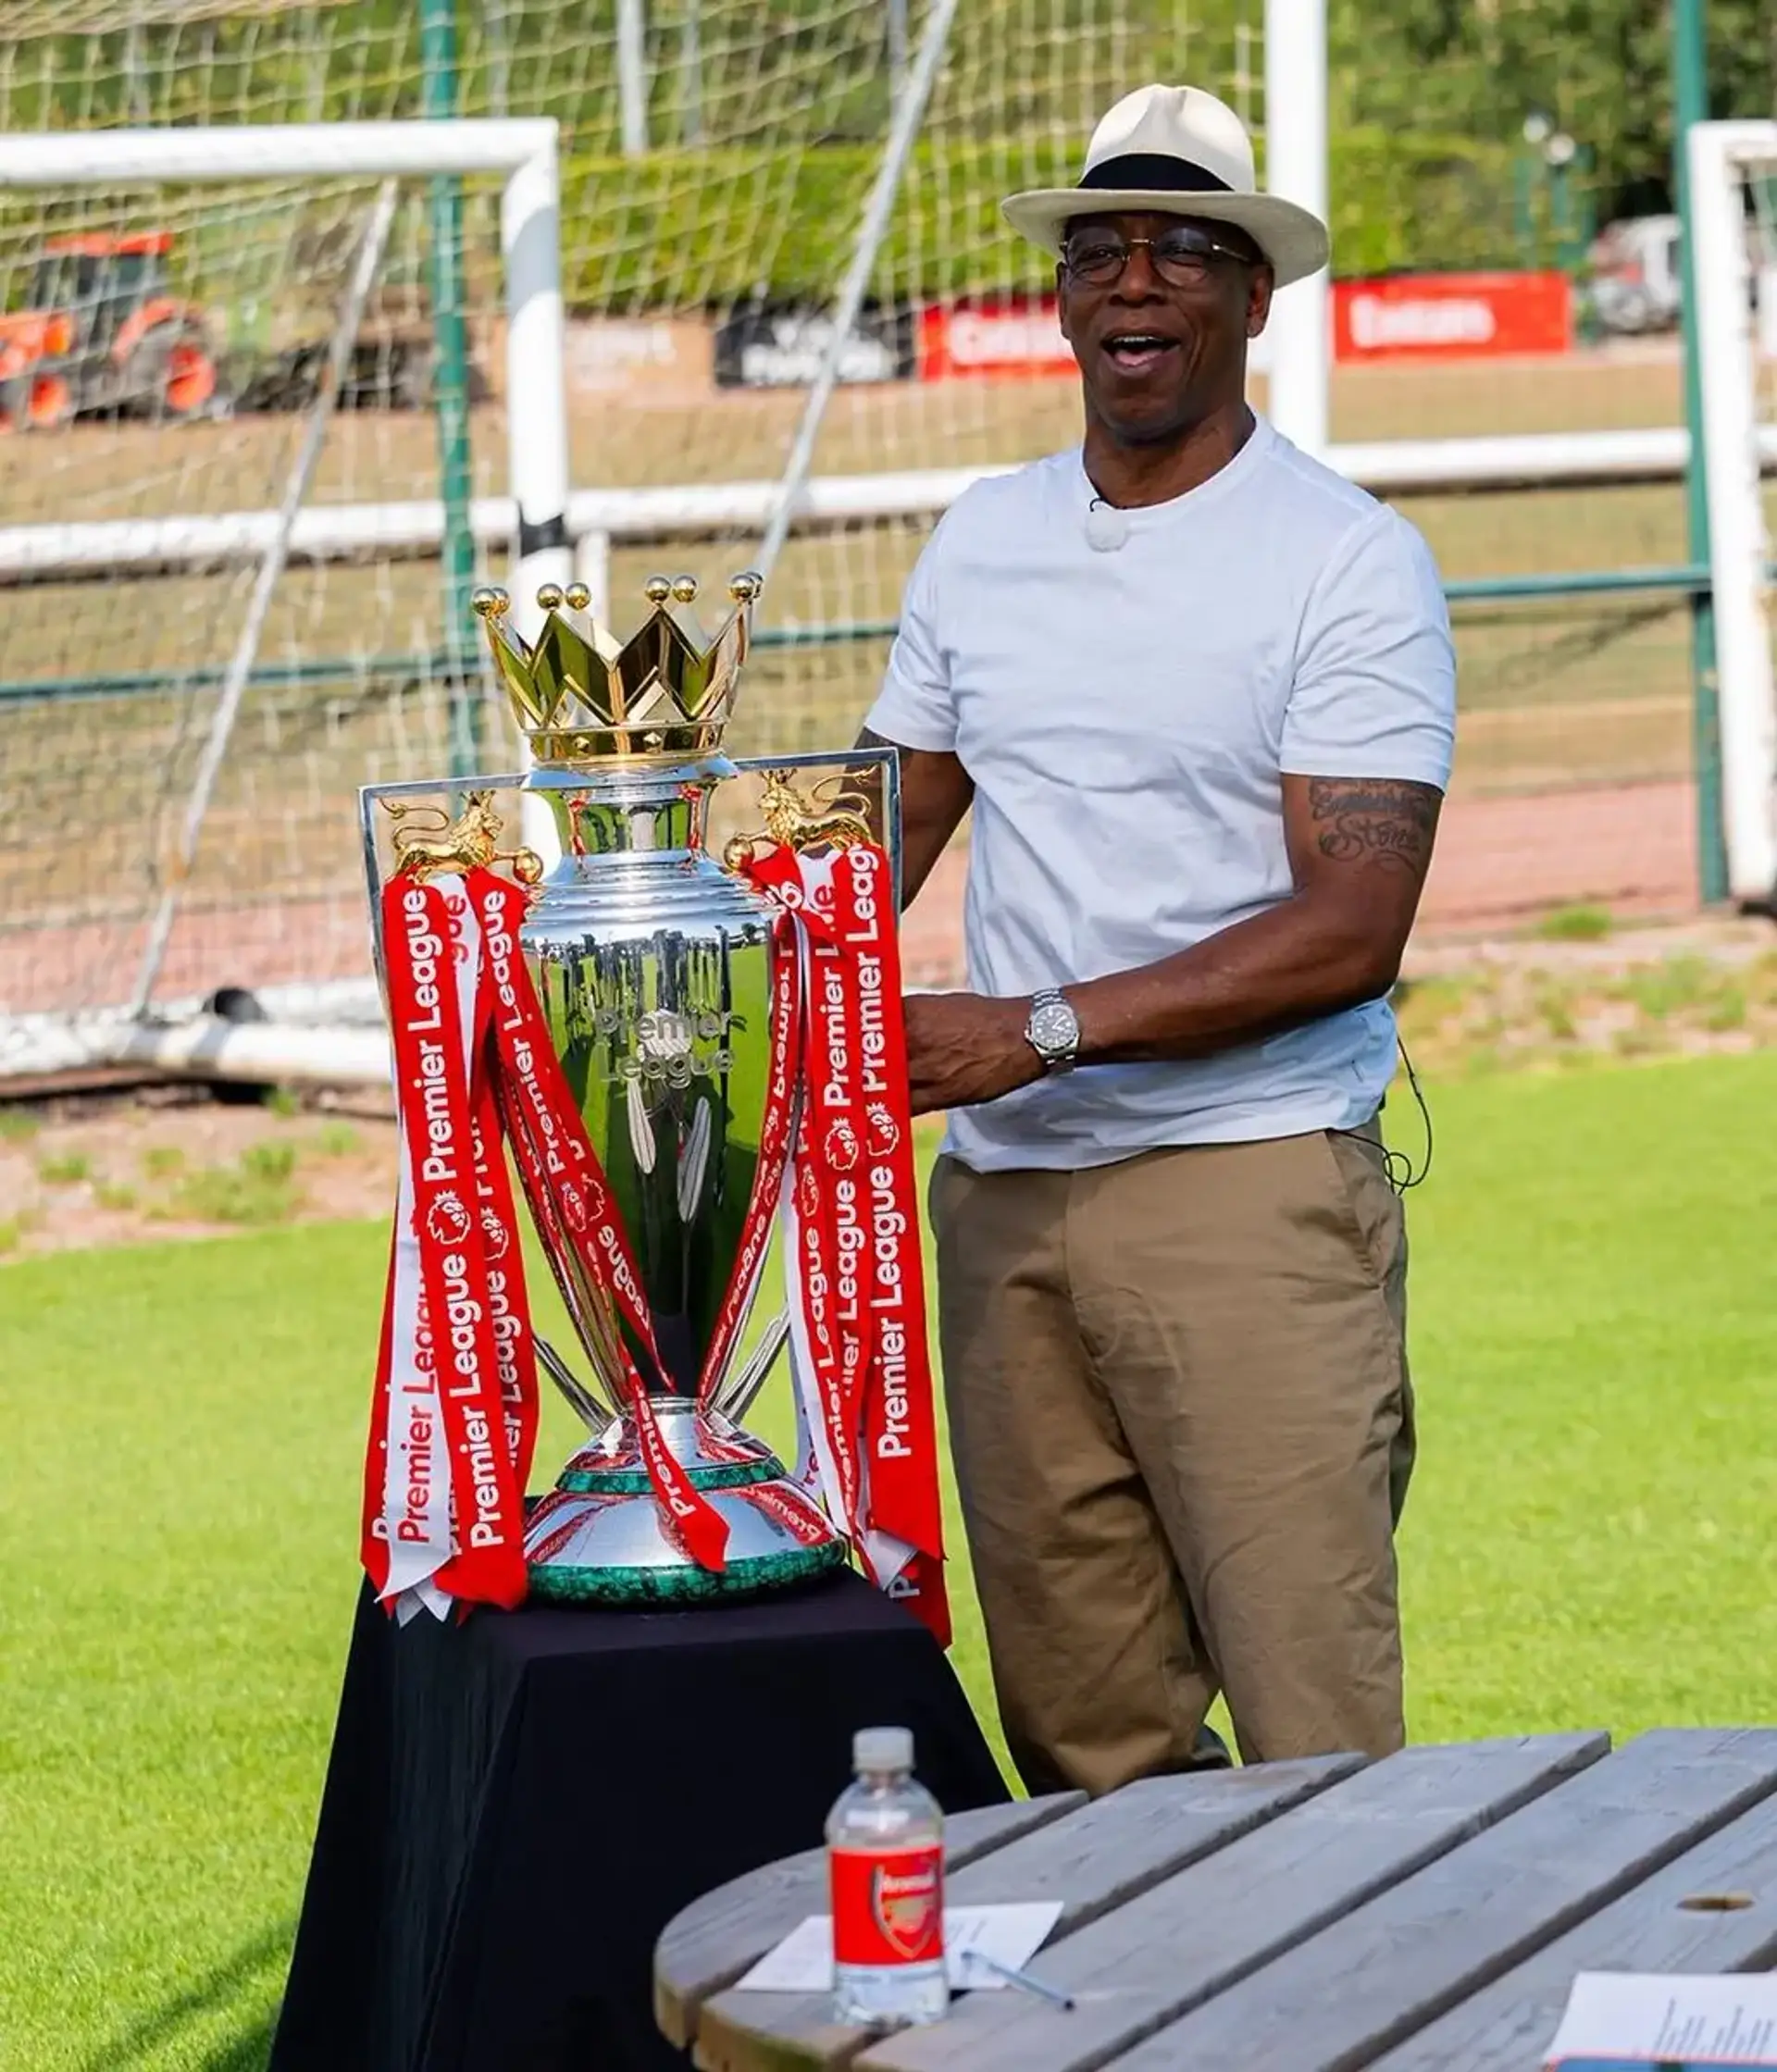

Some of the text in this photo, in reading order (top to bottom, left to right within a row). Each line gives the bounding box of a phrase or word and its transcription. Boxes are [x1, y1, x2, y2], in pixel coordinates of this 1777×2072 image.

[483, 890, 523, 1031] League
[846, 843, 888, 1092] Premier Leag
[403, 889, 456, 1182] Premier League
[513, 1037, 565, 1174] Premier
[819, 967, 851, 1107] Premier
[806, 1227, 835, 1369] League
[837, 1180, 866, 1321] League
[870, 1166, 912, 1458] Premier League
[442, 1254, 504, 1548] Premier League
[487, 1271, 522, 1403] League
[397, 1405, 433, 1544] Premier
[636, 1386, 696, 1518] Premier
